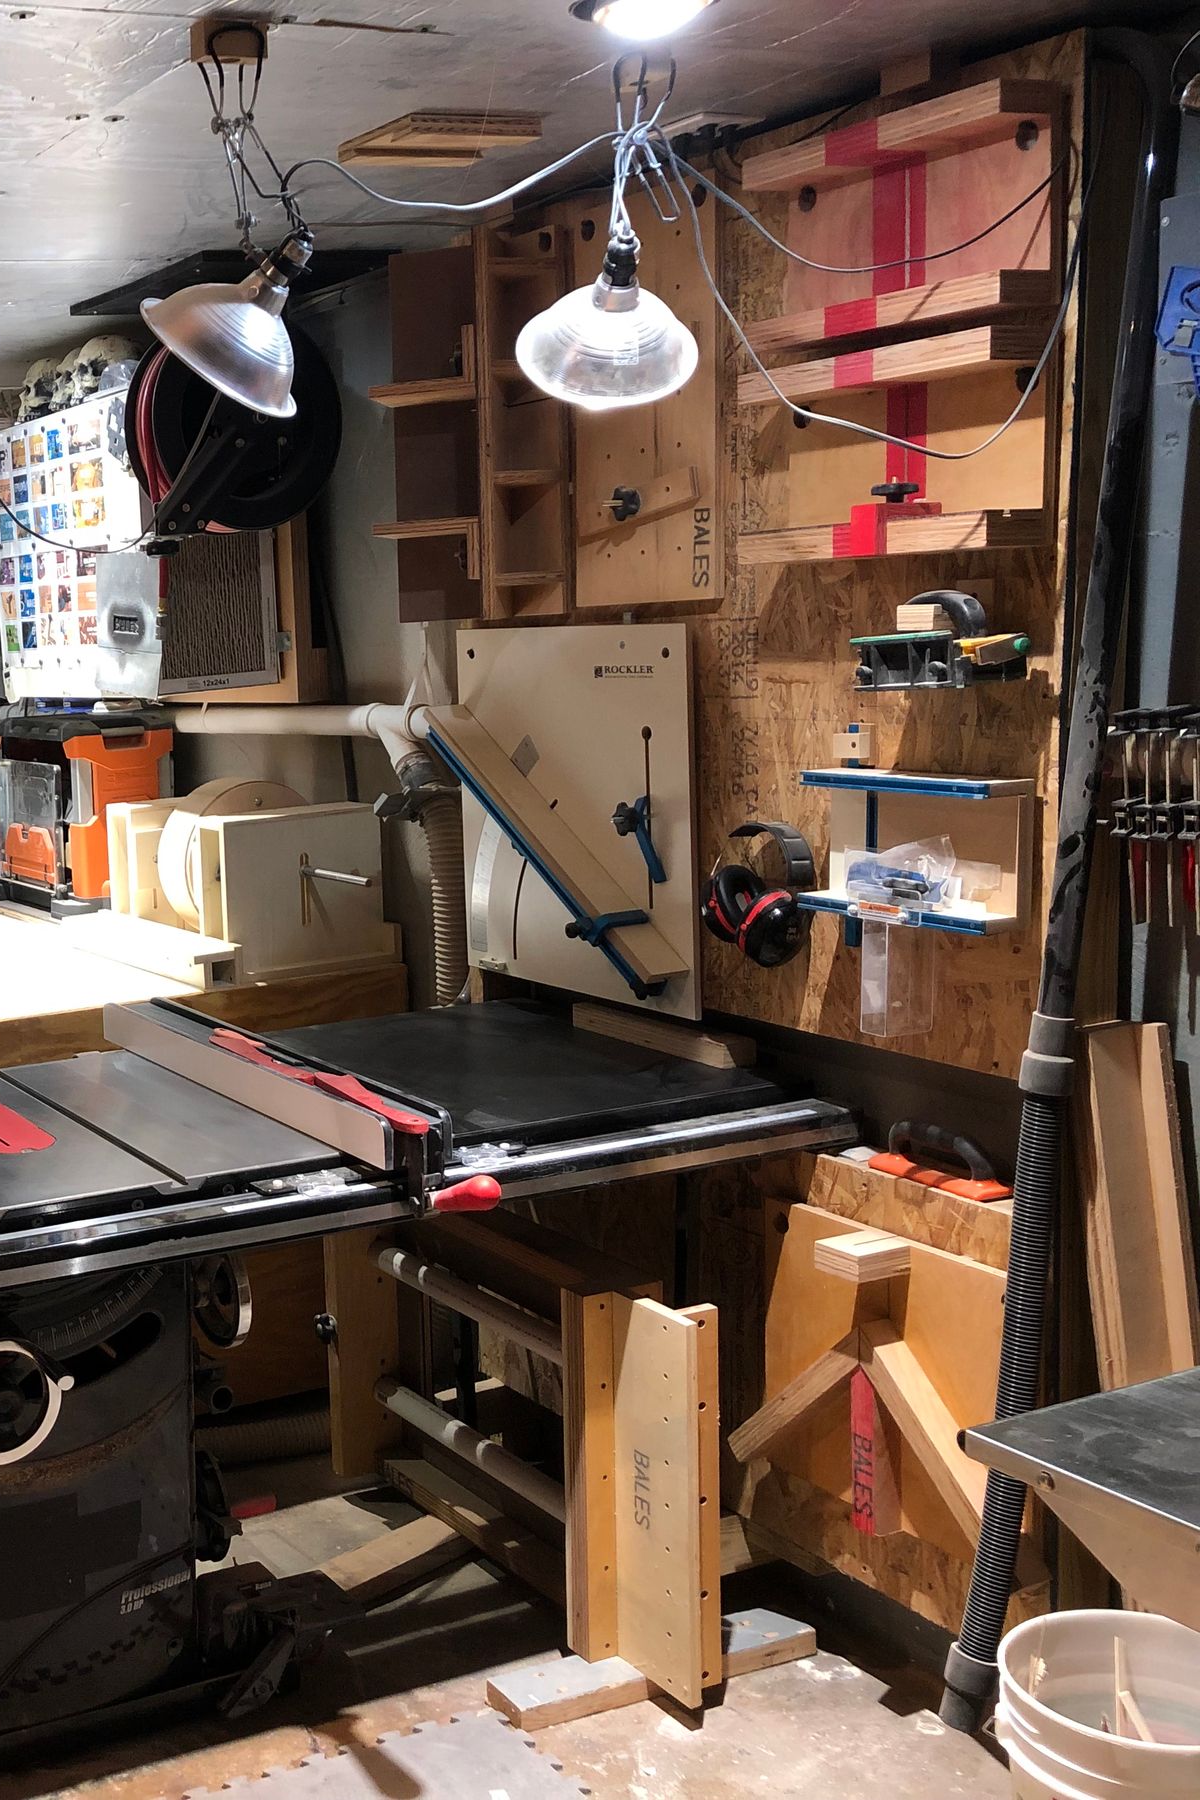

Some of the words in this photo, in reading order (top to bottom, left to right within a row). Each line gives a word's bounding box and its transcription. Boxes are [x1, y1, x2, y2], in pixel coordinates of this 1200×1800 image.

[693, 508, 711, 588] BALES
[203, 678, 230, 687] 12x24x1
[604, 665, 654, 674] ROCKLER
[731, 632, 745, 685] 2014
[634, 1449, 650, 1530] BALES
[854, 1433, 873, 1518] BALES
[121, 1570, 191, 1604] Professional
